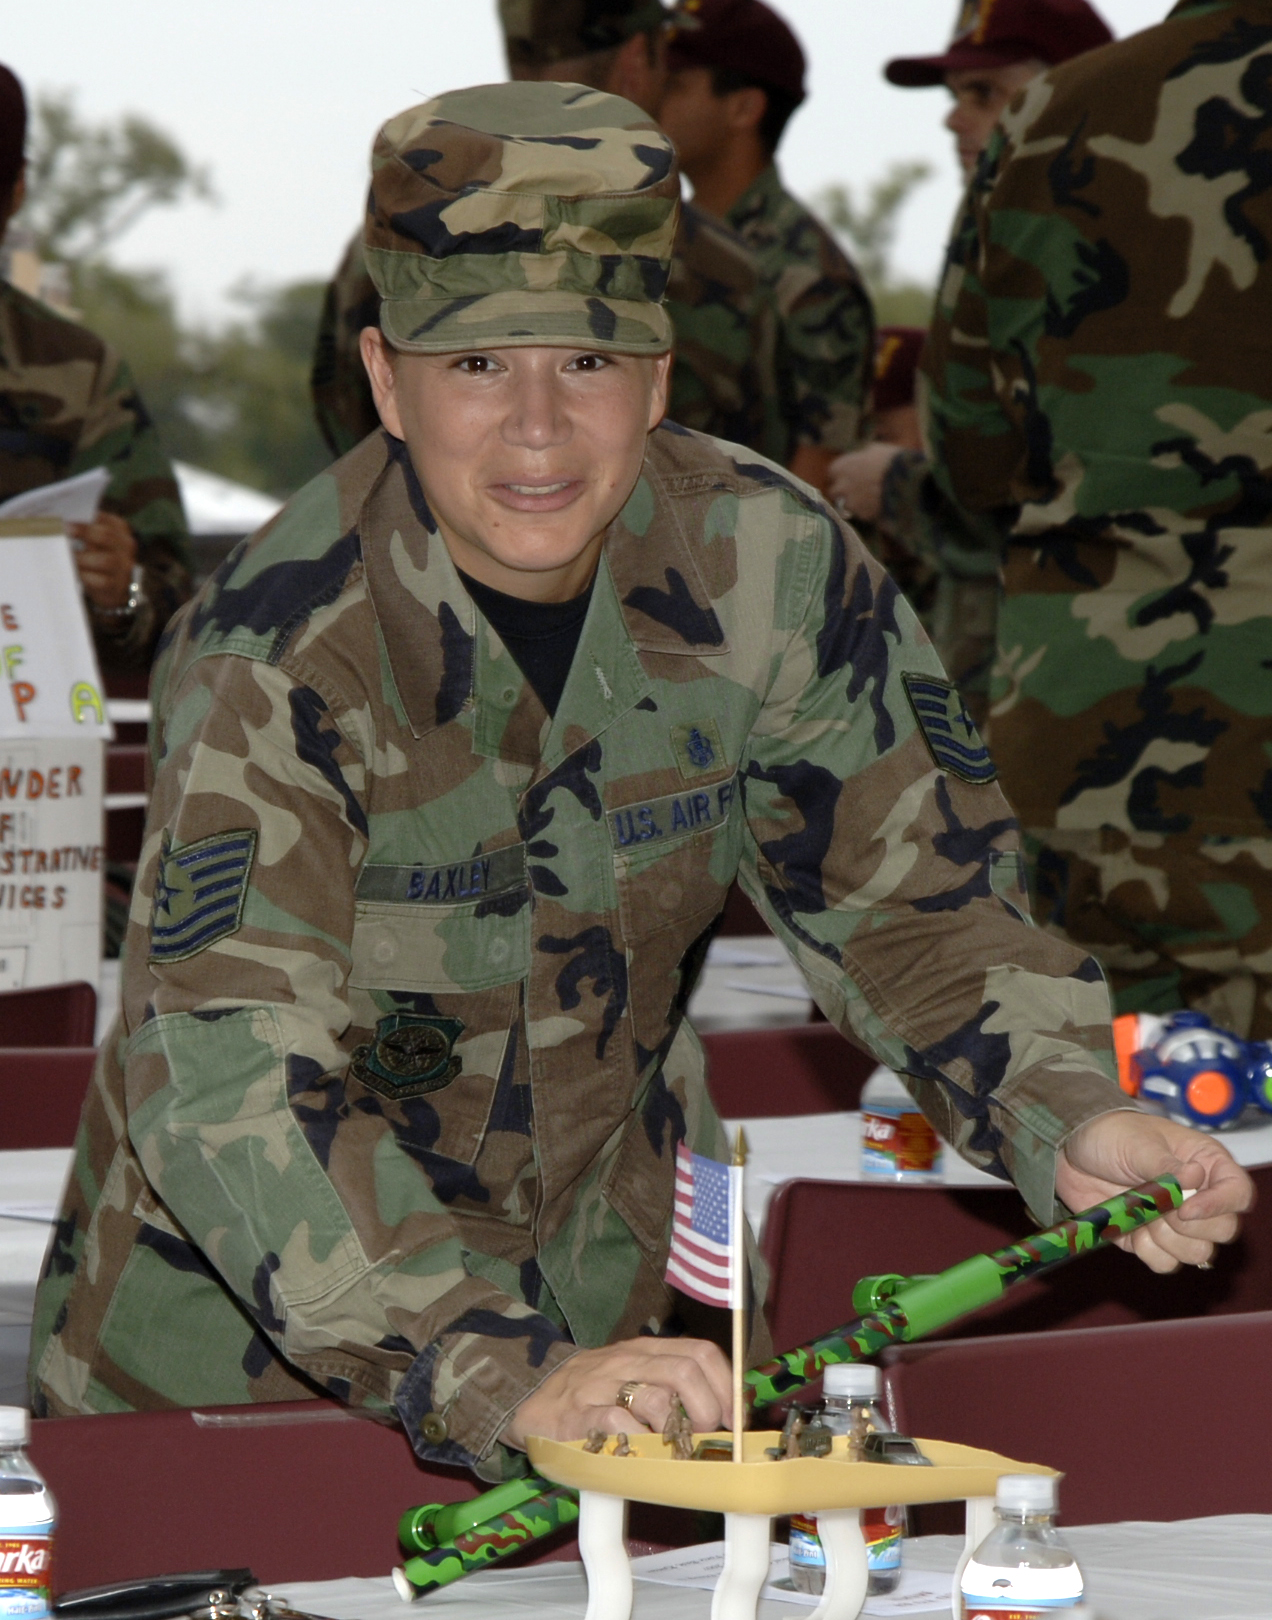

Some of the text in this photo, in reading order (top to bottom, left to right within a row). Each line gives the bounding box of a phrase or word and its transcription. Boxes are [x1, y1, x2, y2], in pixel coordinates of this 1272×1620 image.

[0, 645, 23, 679] F
[11, 681, 105, 725] P A
[0, 765, 82, 800] NDER
[615, 784, 735, 845] U.S. AIR F
[406, 858, 490, 900] BAXLEY
